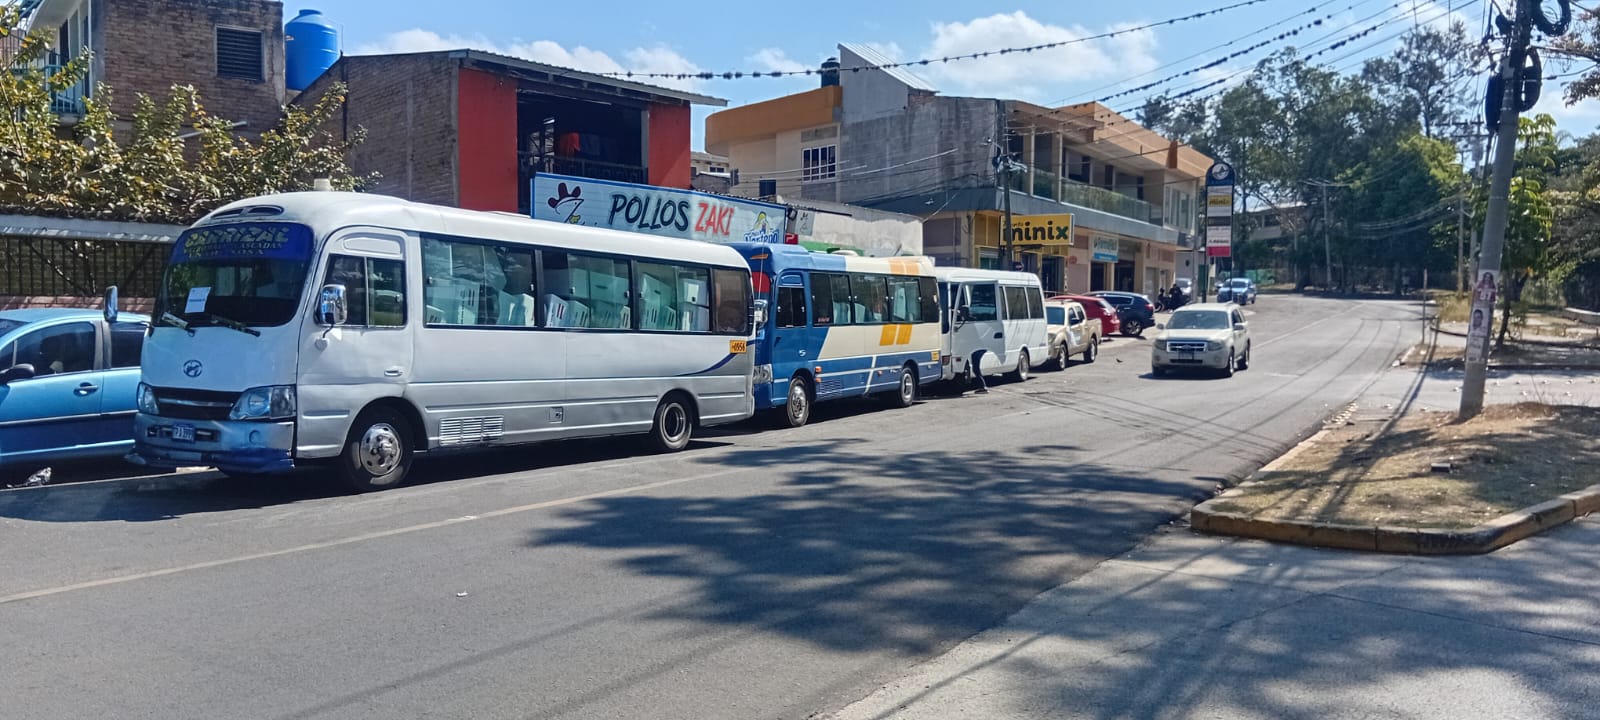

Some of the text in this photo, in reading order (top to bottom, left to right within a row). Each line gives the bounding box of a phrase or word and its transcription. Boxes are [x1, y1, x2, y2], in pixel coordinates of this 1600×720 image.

[609, 194, 735, 236] POLLOS ZAKI
[1003, 220, 1069, 241] minix
